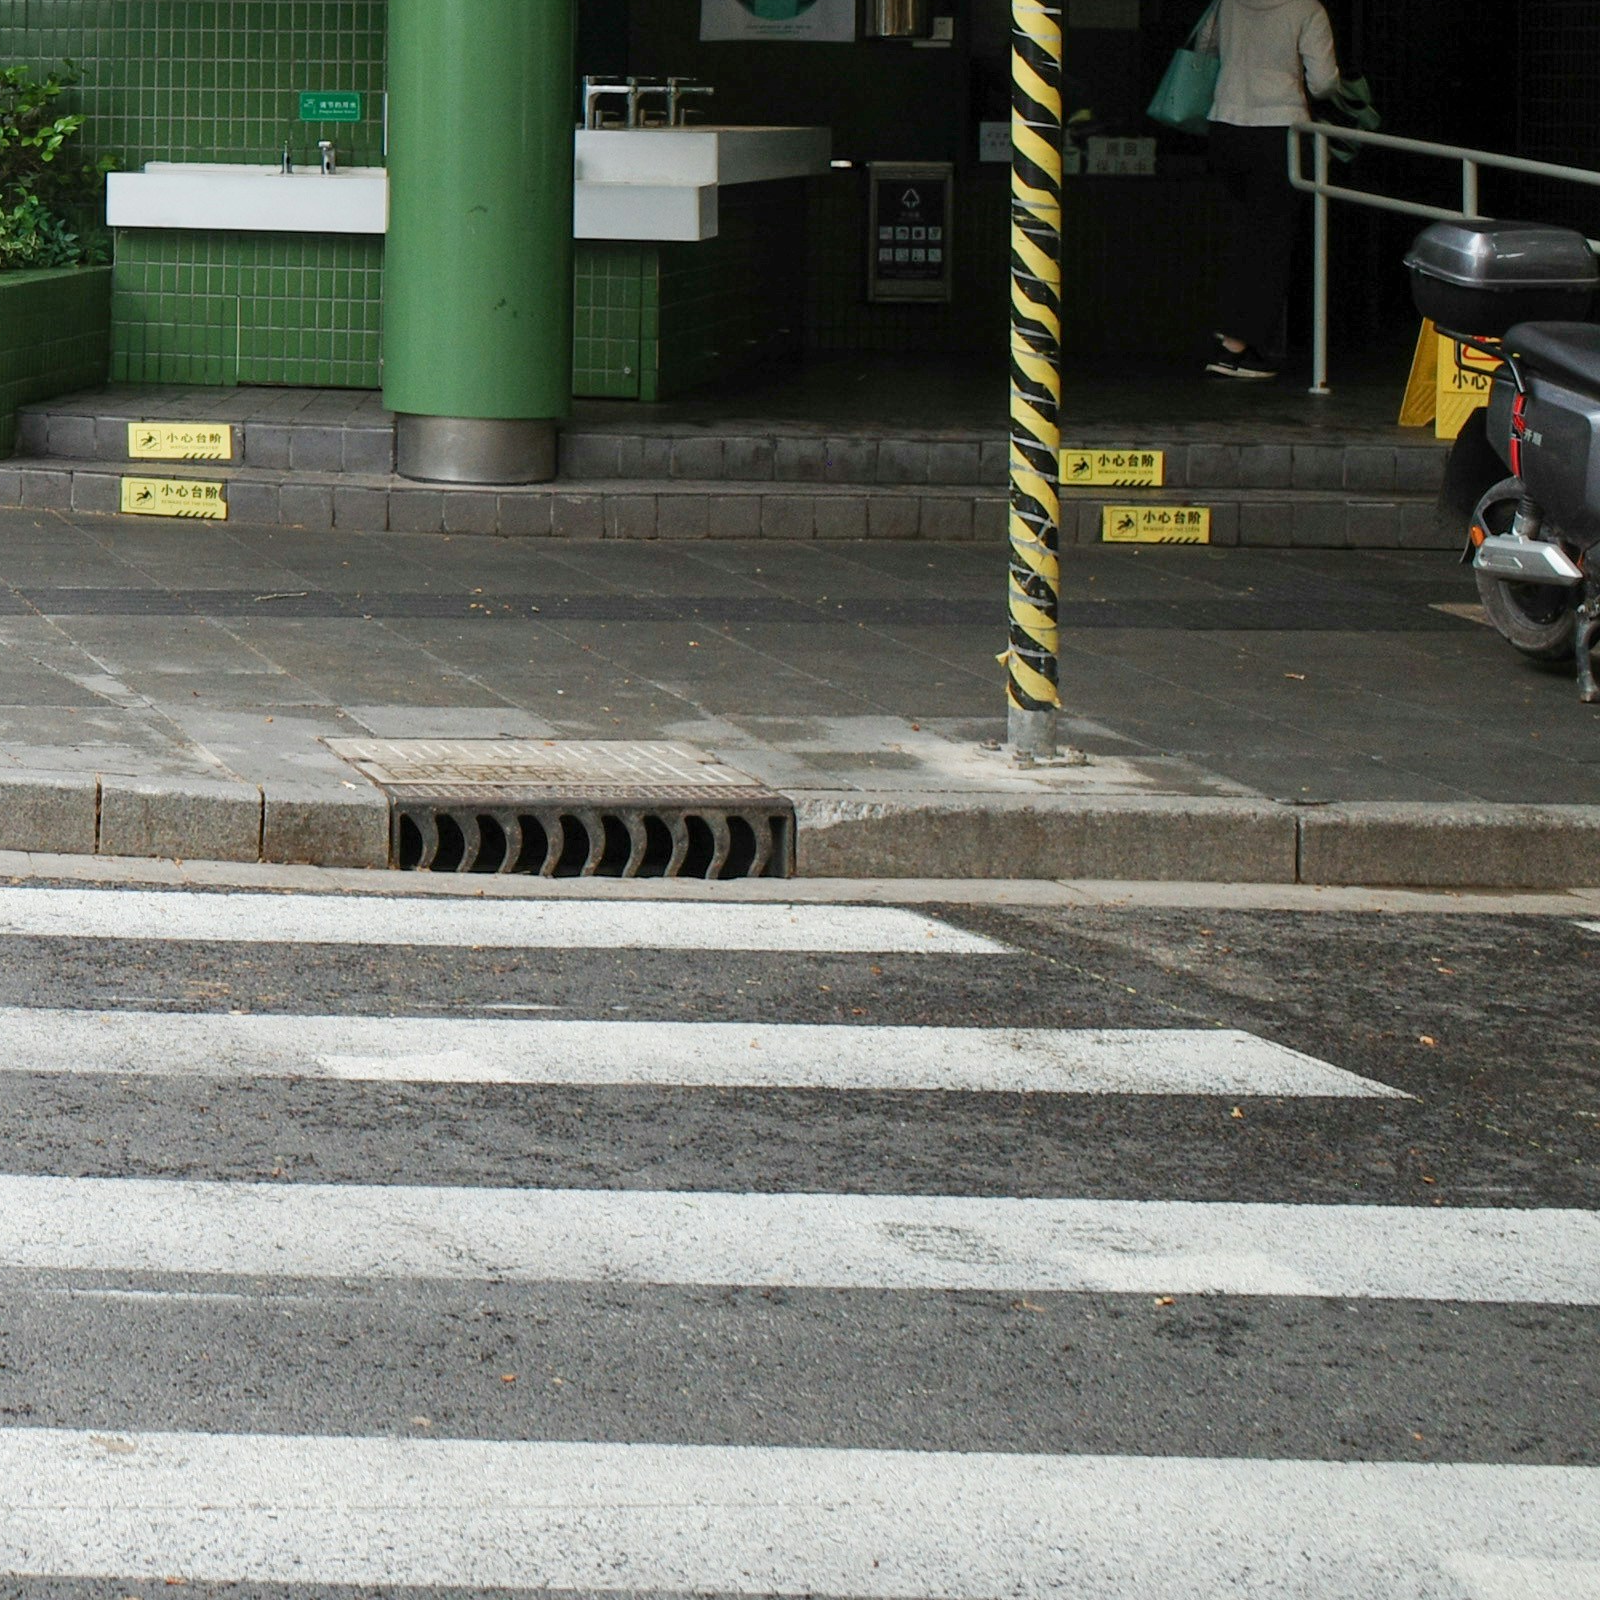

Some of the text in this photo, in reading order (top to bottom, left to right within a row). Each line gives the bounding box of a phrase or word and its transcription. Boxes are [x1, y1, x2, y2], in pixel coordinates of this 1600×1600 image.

[165, 432, 221, 444] 小心台阶
[1098, 453, 1154, 467] 小心台阶
[161, 483, 218, 499] 小心台阶
[1143, 510, 1201, 524] 小心台阶
